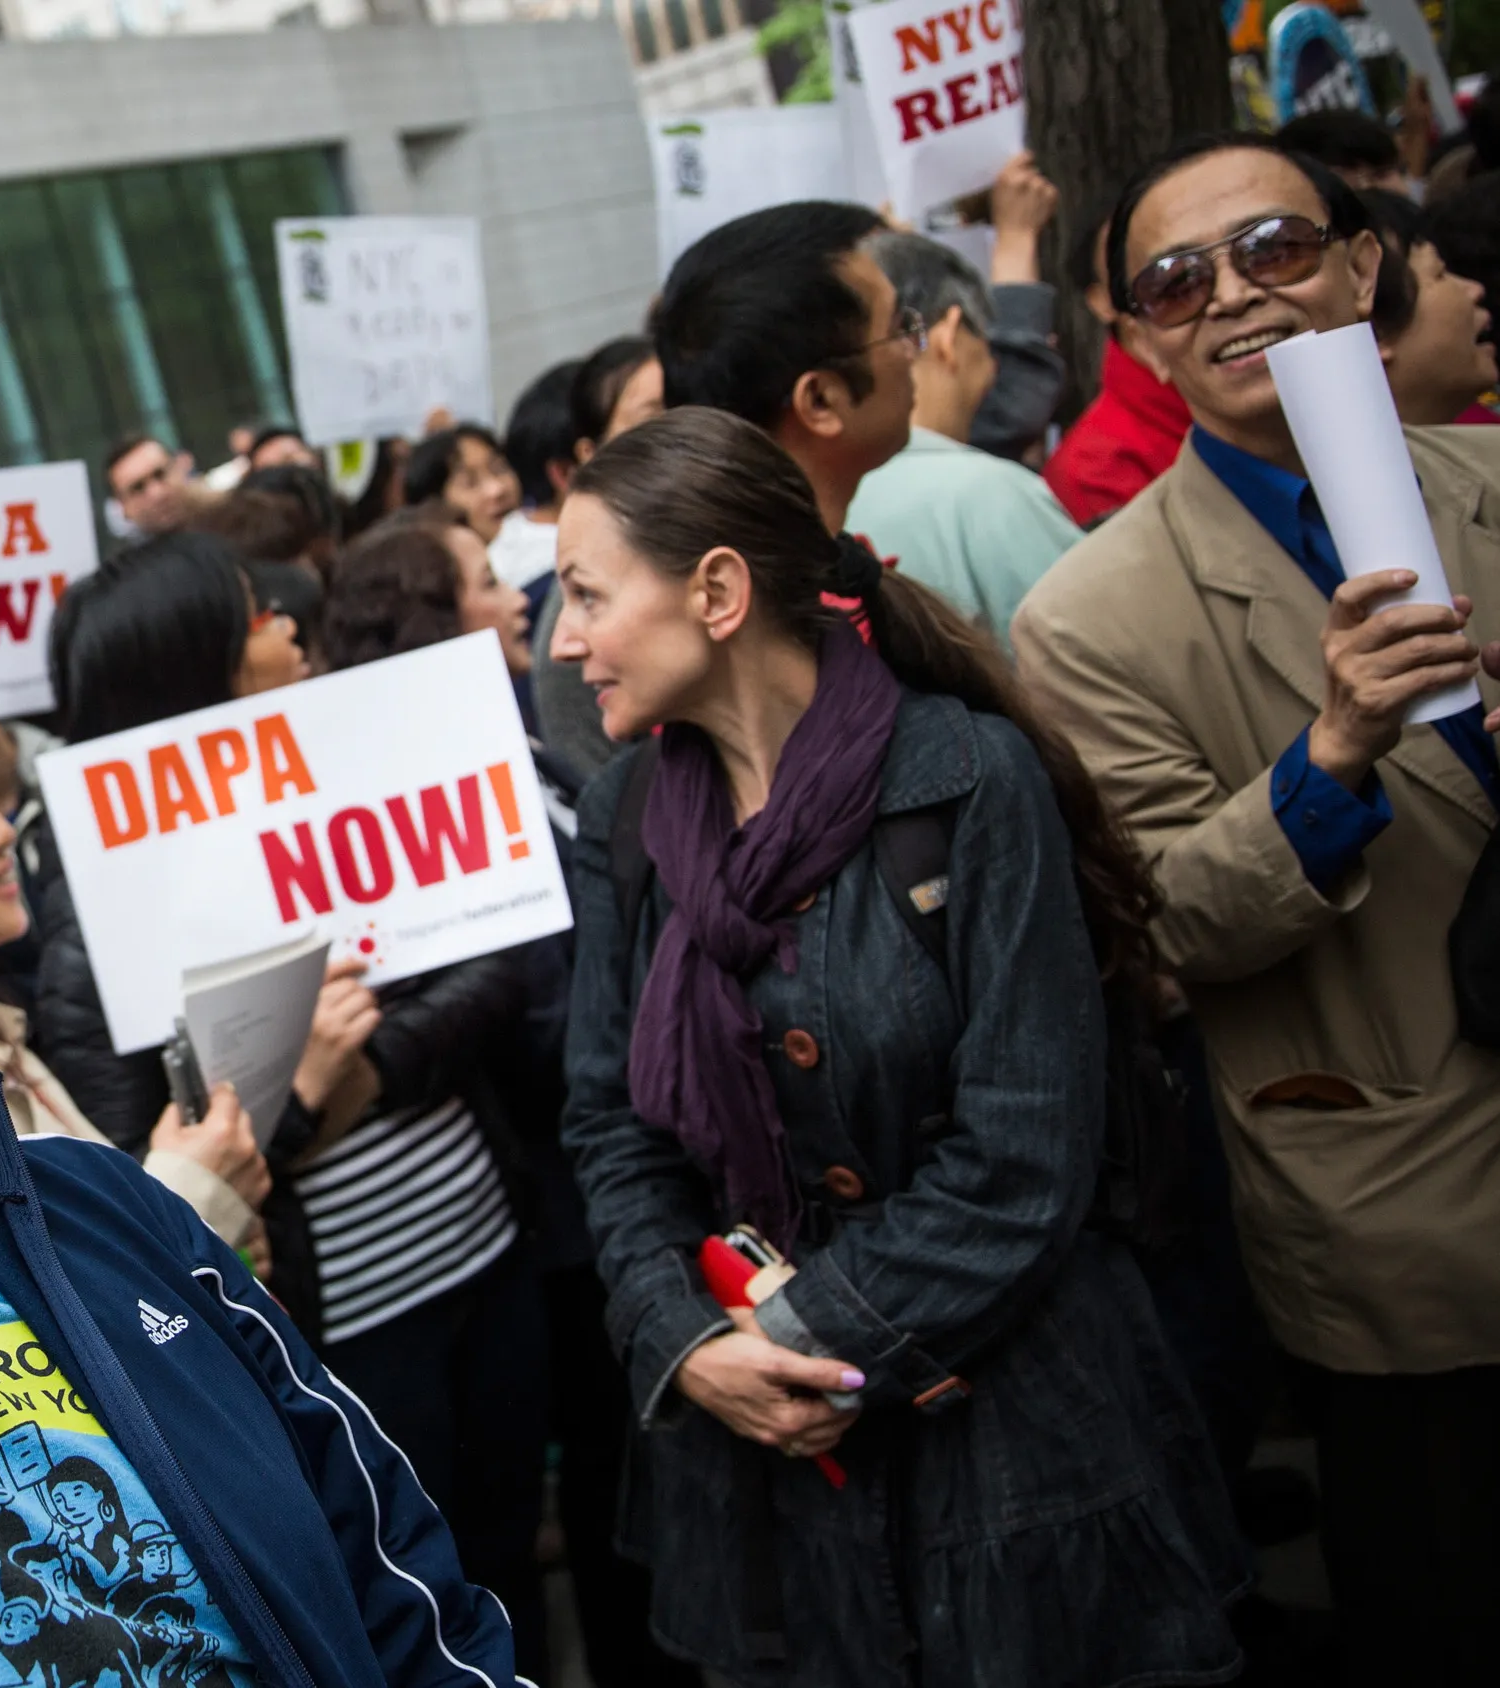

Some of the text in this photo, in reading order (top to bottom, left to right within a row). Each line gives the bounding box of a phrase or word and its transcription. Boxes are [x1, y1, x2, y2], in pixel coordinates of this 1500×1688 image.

[894, 0, 1004, 72] NYC
[894, 56, 1021, 142] REA
[82, 713, 317, 850] DAPA
[258, 761, 530, 924] NOW!
[148, 1315, 189, 1345] adidas
